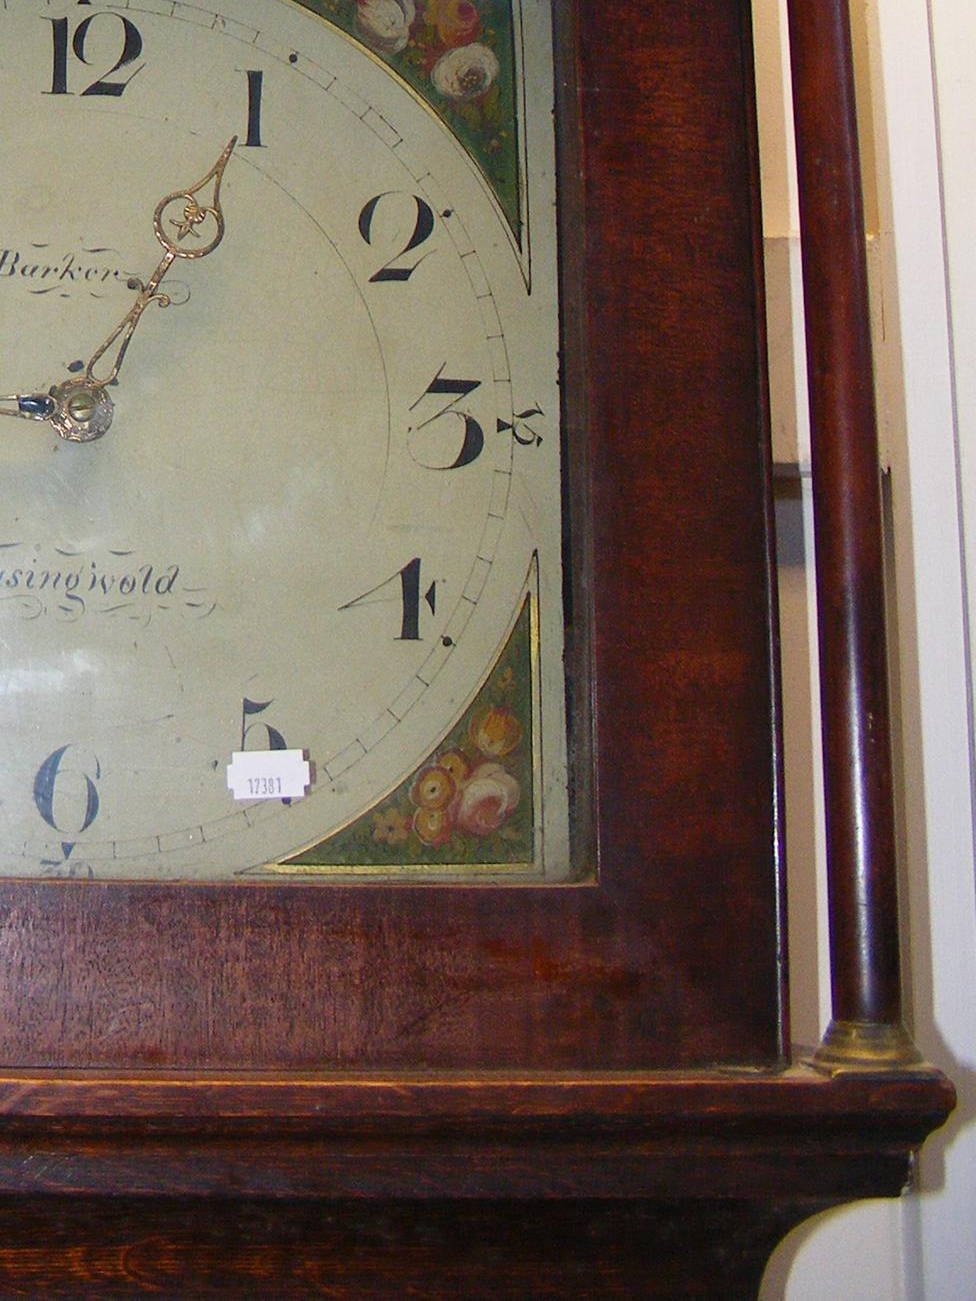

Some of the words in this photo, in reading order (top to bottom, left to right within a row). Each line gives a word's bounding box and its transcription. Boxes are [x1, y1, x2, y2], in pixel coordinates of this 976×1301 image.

[40, 11, 145, 97] 12
[235, 69, 268, 148] 1
[358, 190, 437, 283] 2
[406, 361, 485, 470] 3
[337, 556, 438, 641] 4
[32, 742, 101, 835] 6
